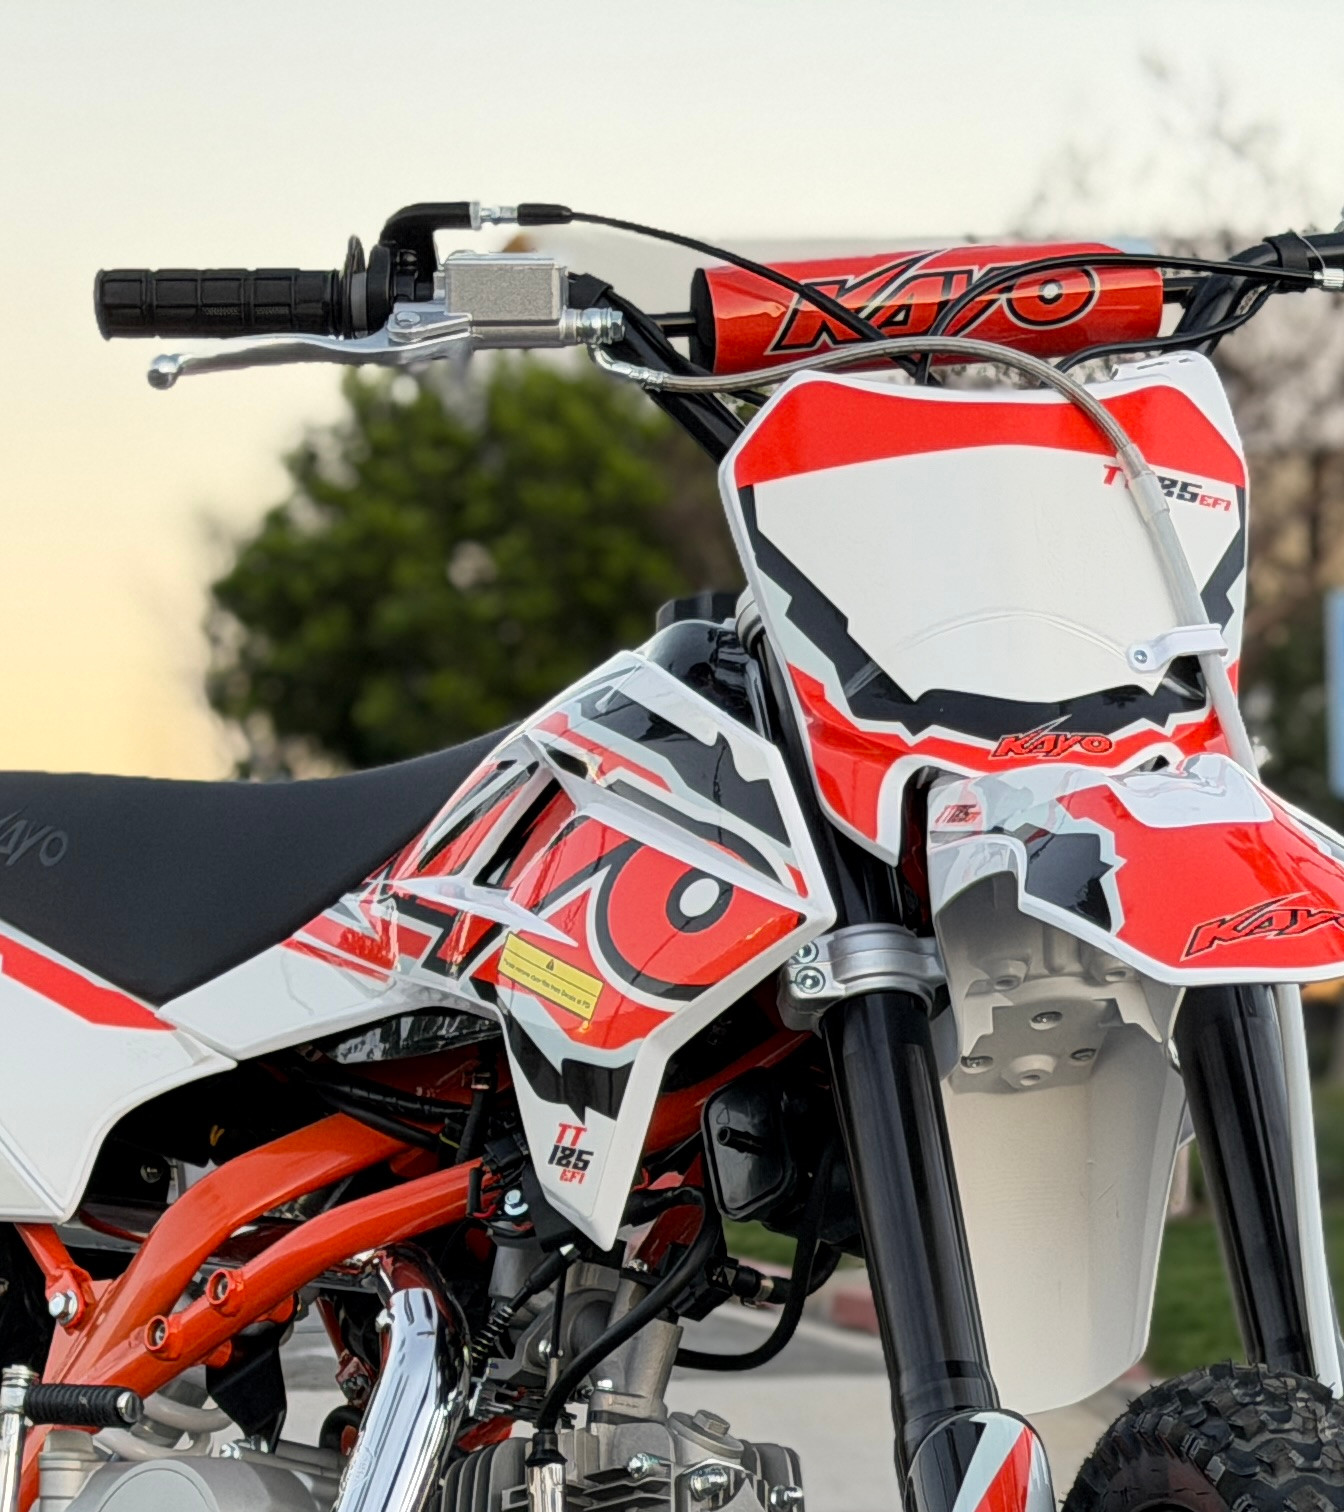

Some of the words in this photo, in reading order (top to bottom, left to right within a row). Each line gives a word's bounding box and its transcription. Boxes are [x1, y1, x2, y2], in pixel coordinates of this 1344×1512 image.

[763, 248, 1100, 356] KAYO
[988, 713, 1115, 759] KAYO
[556, 1122, 587, 1147] TT
[548, 1144, 594, 1171] 125
